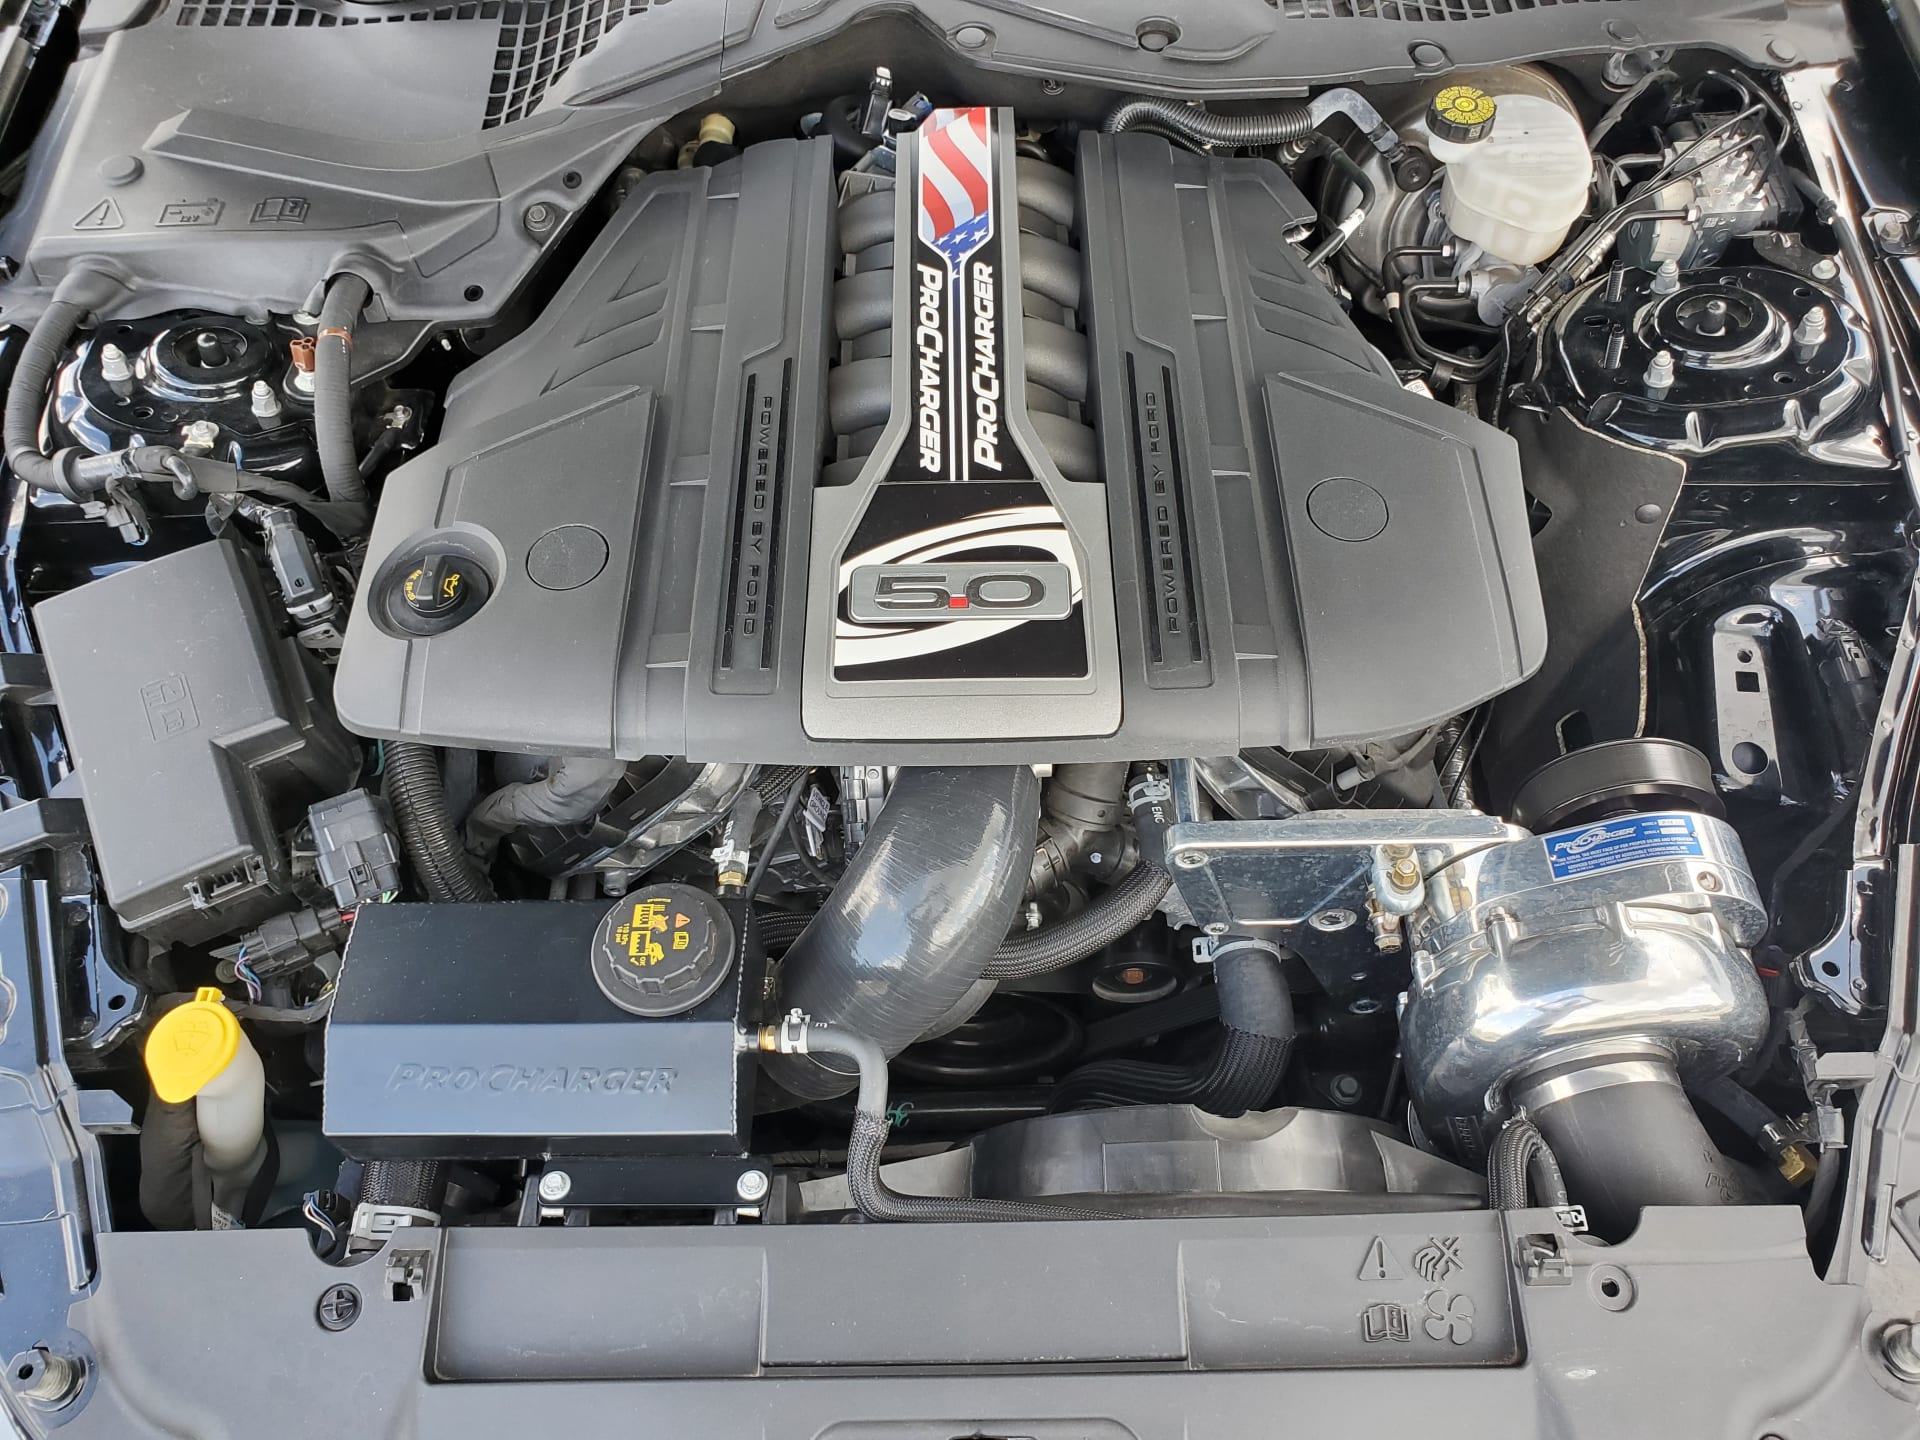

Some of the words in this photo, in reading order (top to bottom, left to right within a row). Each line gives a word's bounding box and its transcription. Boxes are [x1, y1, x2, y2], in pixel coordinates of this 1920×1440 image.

[753, 395, 774, 511] POWERED
[1145, 391, 1163, 456] FORD
[1152, 464, 1167, 497] BY
[750, 521, 763, 556] BY
[1157, 505, 1182, 635] POWERED
[743, 564, 761, 636] FORD
[874, 572, 1047, 611] 5.0
